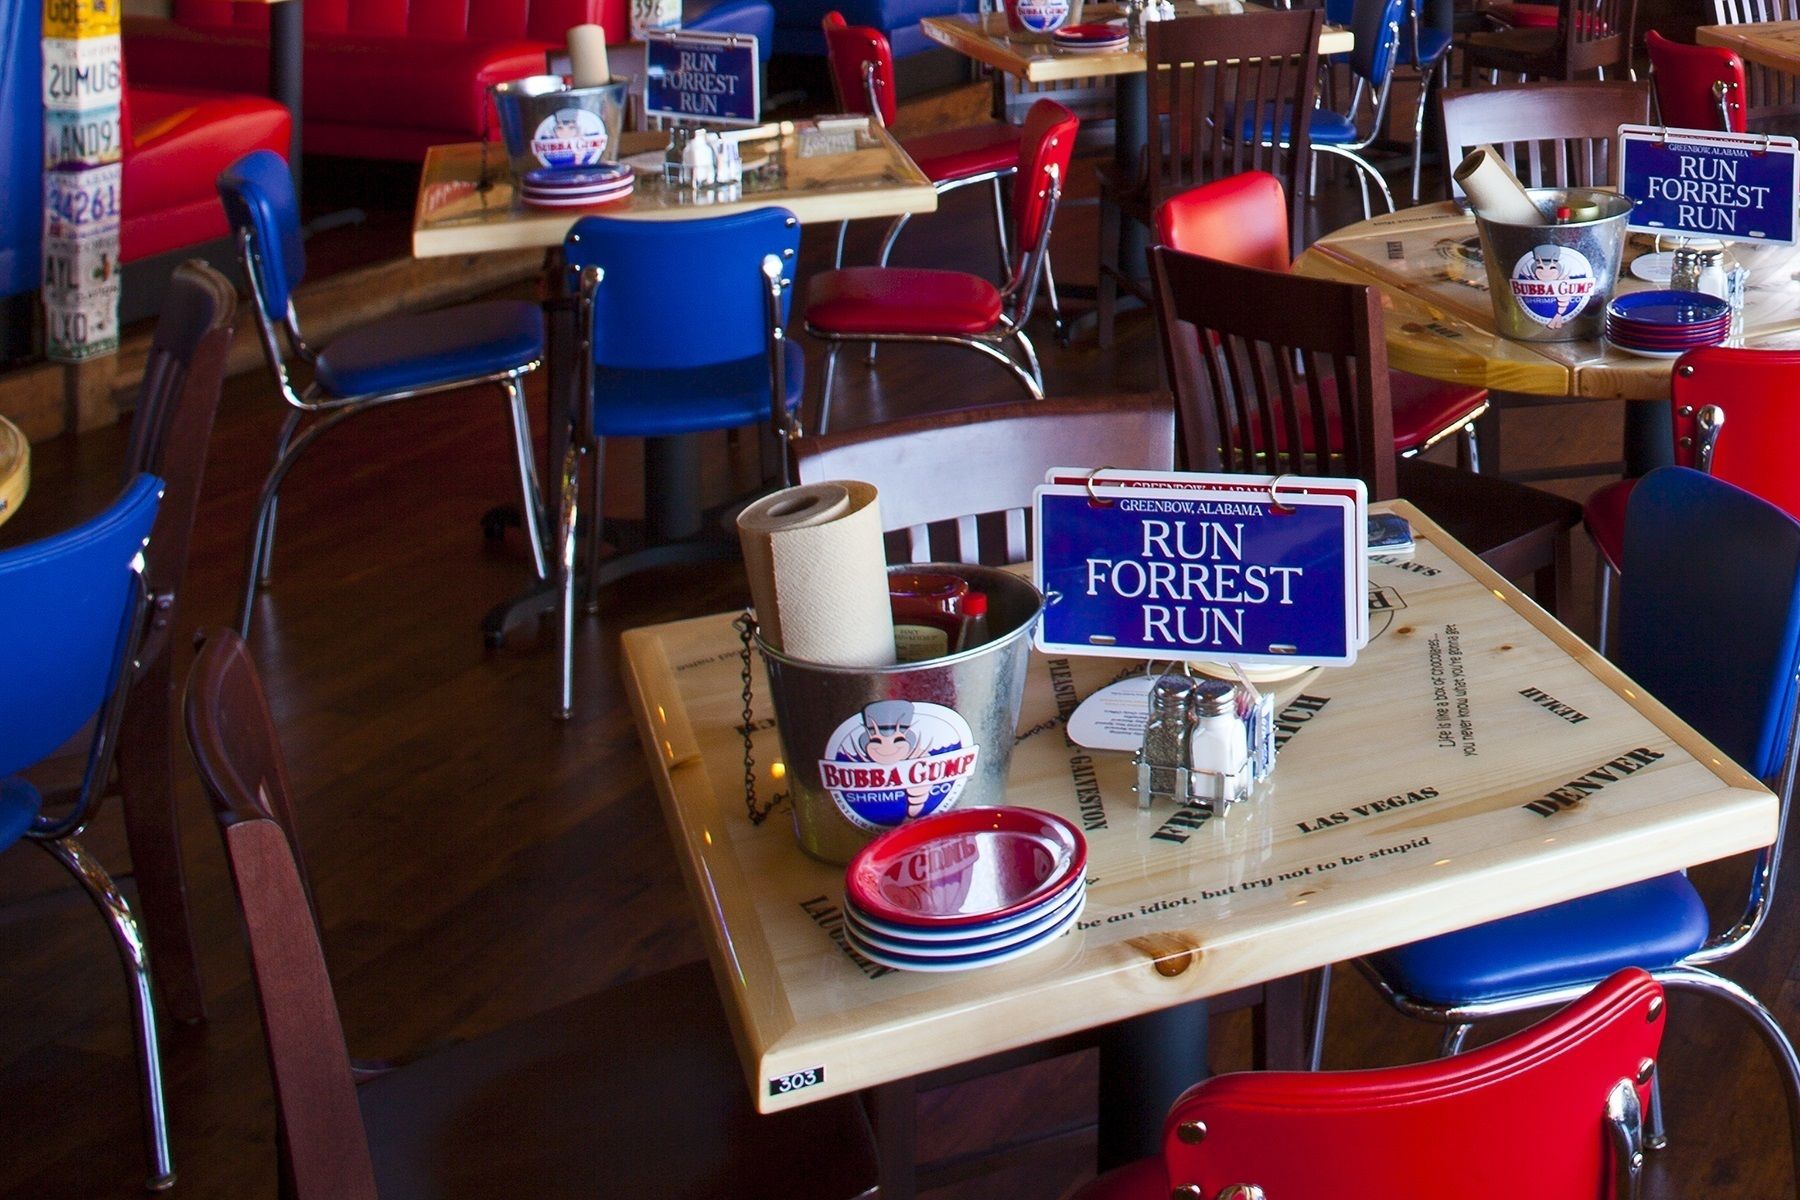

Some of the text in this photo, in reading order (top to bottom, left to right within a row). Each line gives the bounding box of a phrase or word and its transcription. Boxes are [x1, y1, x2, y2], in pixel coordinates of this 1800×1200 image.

[680, 51, 717, 72] RUN
[661, 69, 739, 96] FORREST
[680, 91, 718, 115] RUN
[1710, 147, 1750, 159] ALABAMA
[1679, 155, 1738, 183] RUN
[1647, 176, 1771, 210] FORREST
[1677, 204, 1736, 232] RUN
[1511, 280, 1594, 297] BUBBA GUMP
[1120, 498, 1263, 517] GREENBOW, ALABAMA
[1141, 519, 1244, 562] RUN
[1086, 559, 1304, 606] FORREST
[1141, 604, 1244, 647] RUN
[1445, 623, 1460, 635] get
[1447, 635, 1463, 656] gonna
[1434, 686, 1448, 701] box
[1453, 678, 1468, 697] what
[1435, 707, 1451, 721] like
[1456, 698, 1470, 718] know
[1518, 686, 1590, 725] KEMAH
[1437, 728, 1456, 749] Life
[1460, 719, 1474, 741] never
[1463, 742, 1478, 757] you
[823, 754, 976, 791] BUBBA GUMP
[1522, 746, 1666, 819] DENVER
[846, 789, 906, 804] SHRIMP
[1070, 755, 1109, 832] GALVESTON
[1295, 785, 1441, 835] LAS VEGAS
[1075, 835, 1433, 932] be an idiot, but try not to be stupid
[777, 1068, 817, 1093] 303
